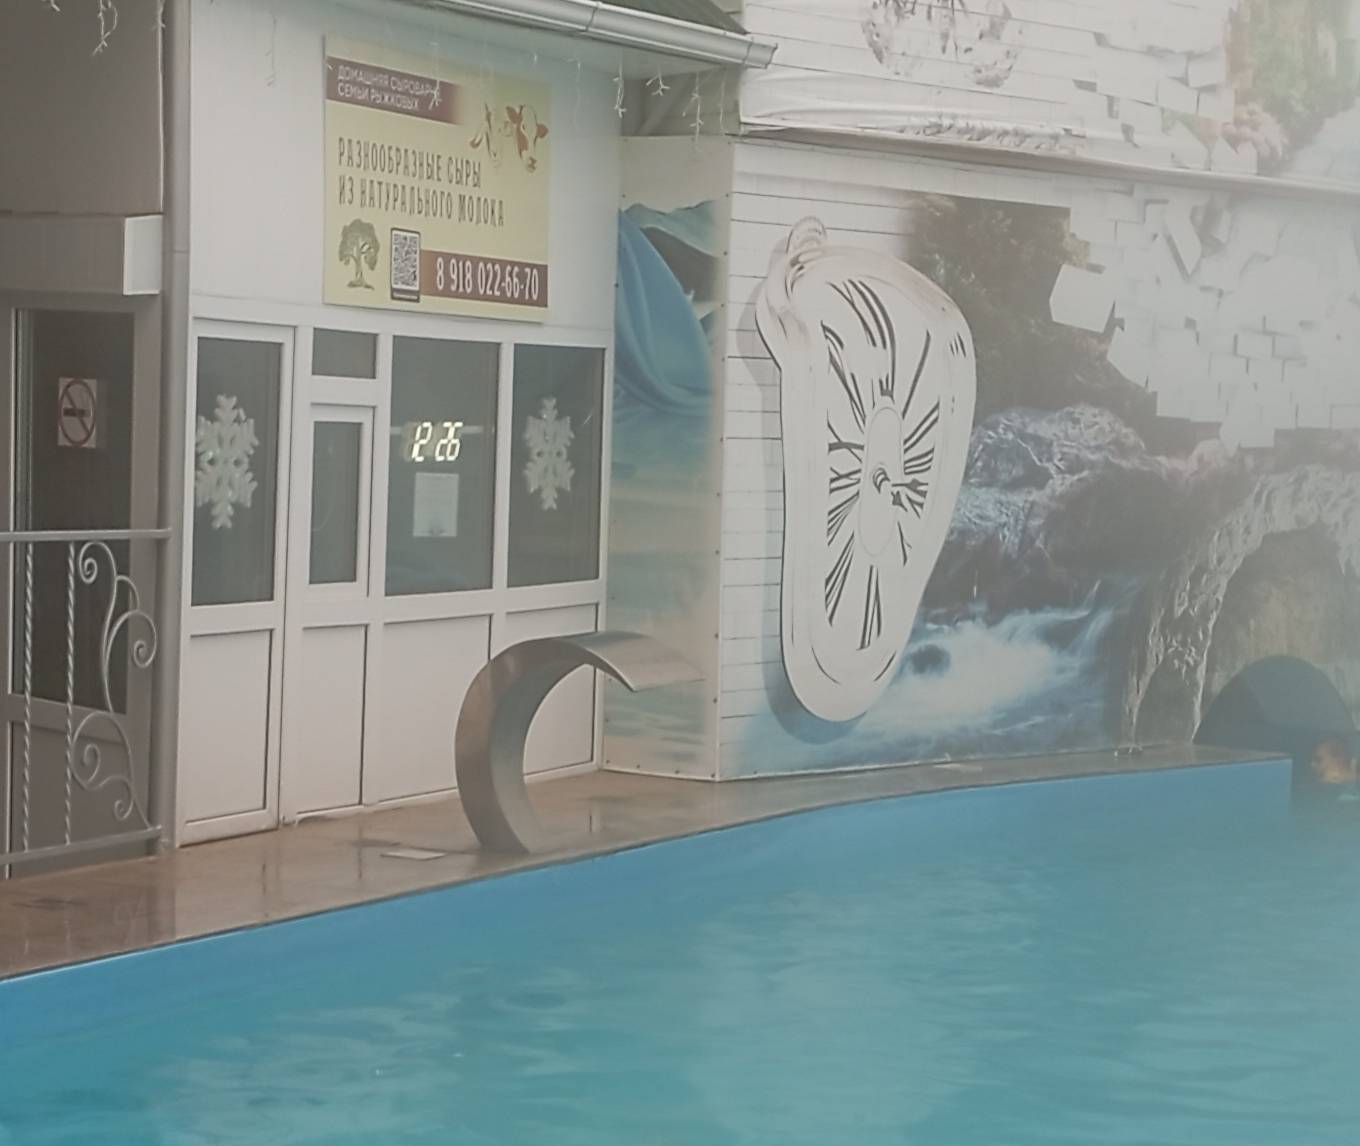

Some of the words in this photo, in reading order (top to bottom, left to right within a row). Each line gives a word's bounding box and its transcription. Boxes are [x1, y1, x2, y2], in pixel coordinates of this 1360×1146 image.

[338, 137, 442, 182] РАЗНООБРАЗНЫЕ
[447, 156, 481, 188] СЫРЫ
[338, 175, 354, 205] ИЗ
[360, 178, 452, 220] НАТУРАЛЬНОГО
[458, 193, 504, 227] МОЛОКА
[436, 256, 445, 291] 8
[449, 258, 473, 294] 918
[477, 262, 540, 300] 022-66-70
